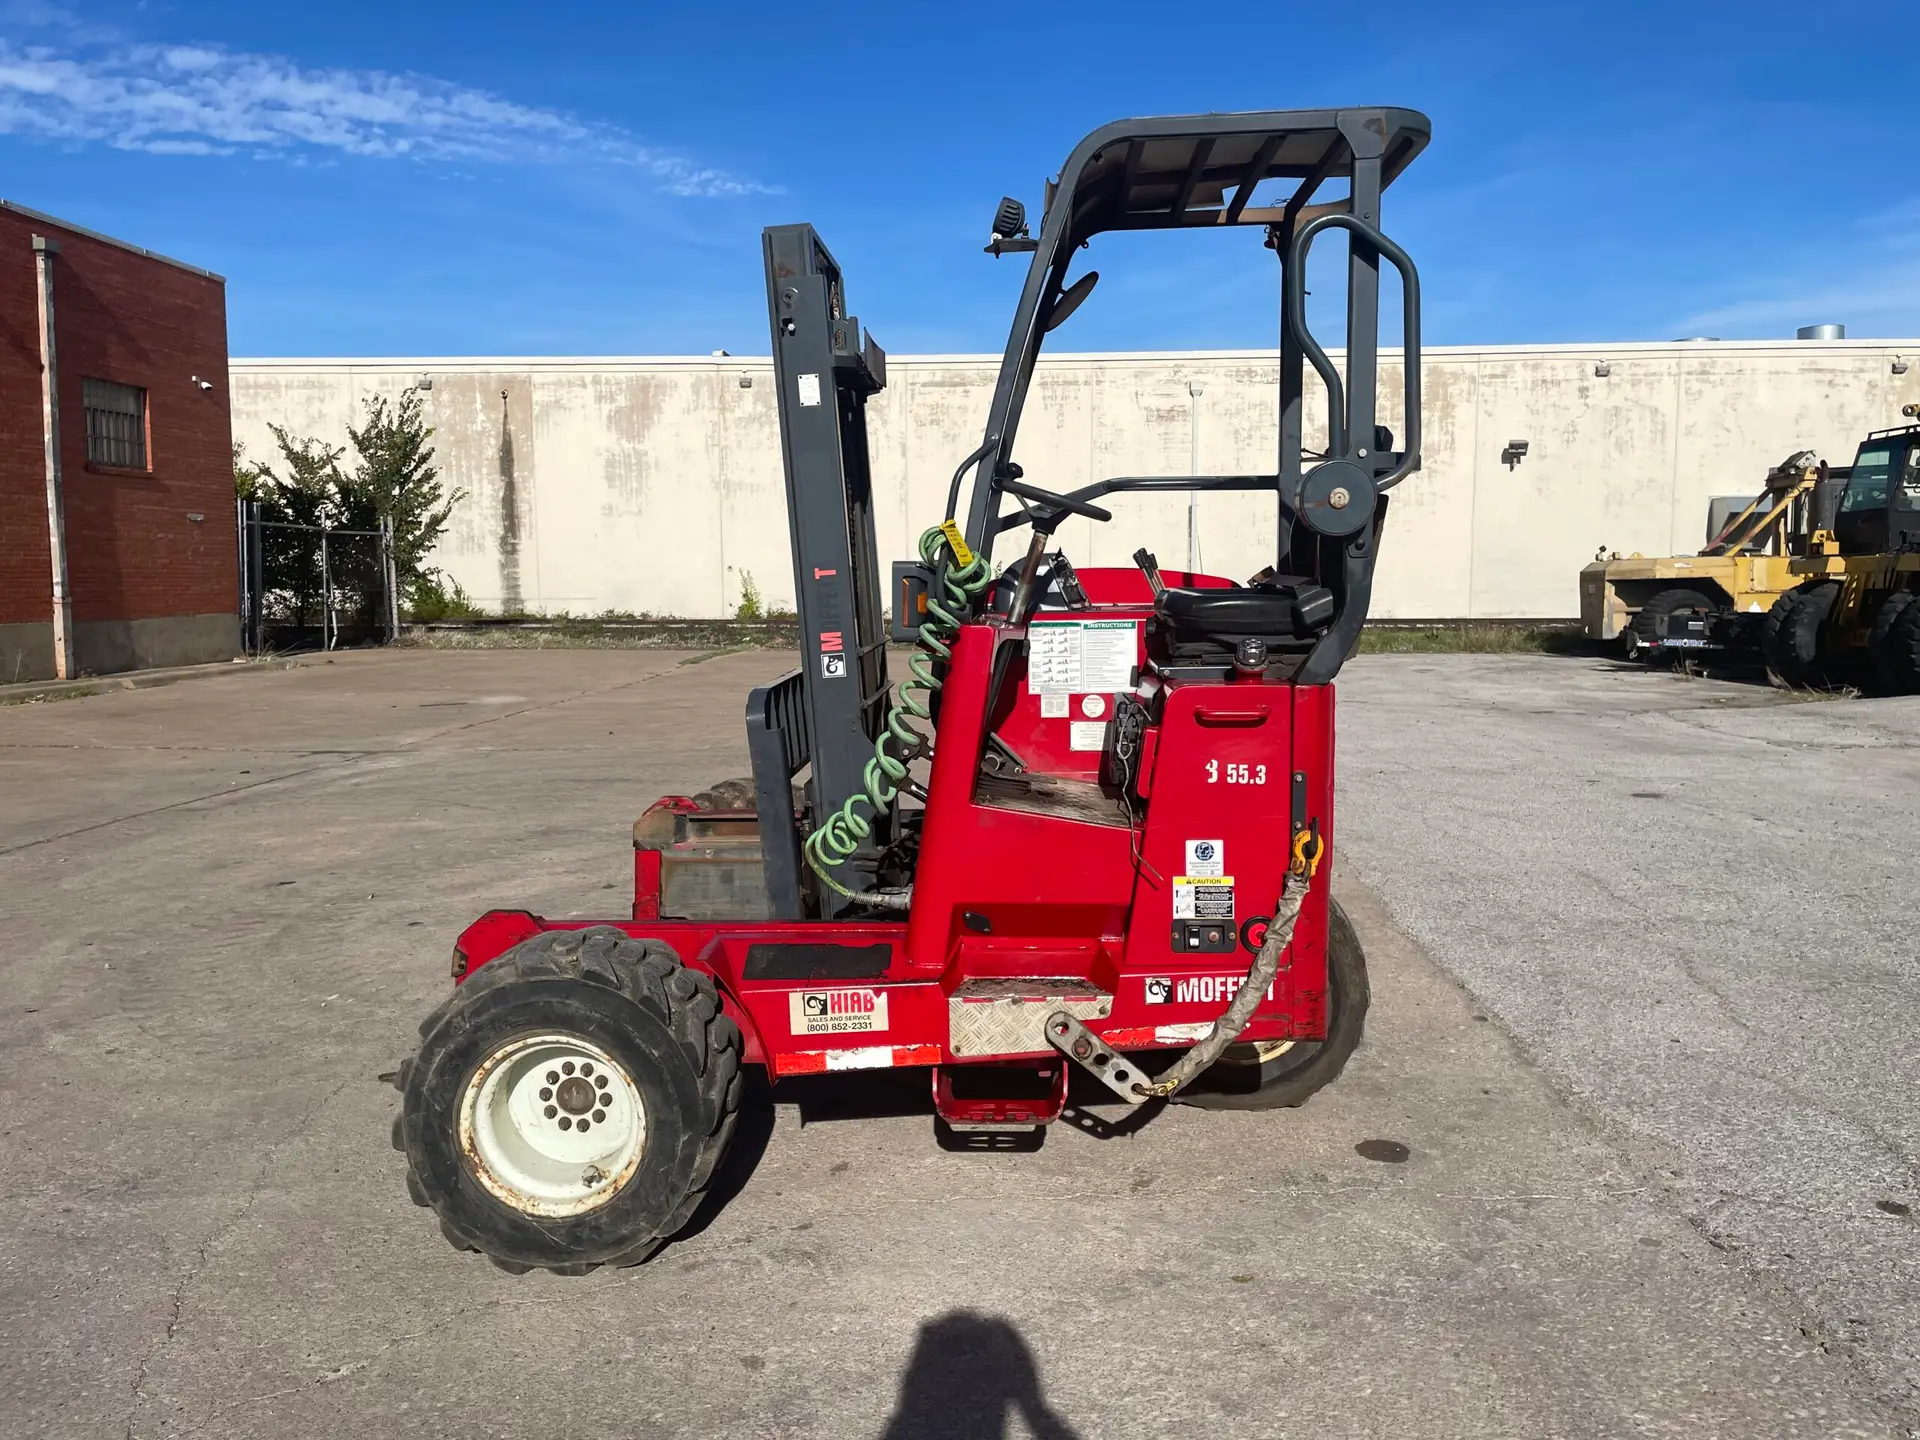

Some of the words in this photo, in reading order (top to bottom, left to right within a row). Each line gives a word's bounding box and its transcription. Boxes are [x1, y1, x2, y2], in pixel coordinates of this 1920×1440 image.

[1226, 763, 1266, 785] 55.3
[830, 991, 875, 1014] HIAB
[806, 1023, 829, 1032] (800)
[831, 1021, 872, 1031] 852-2331
